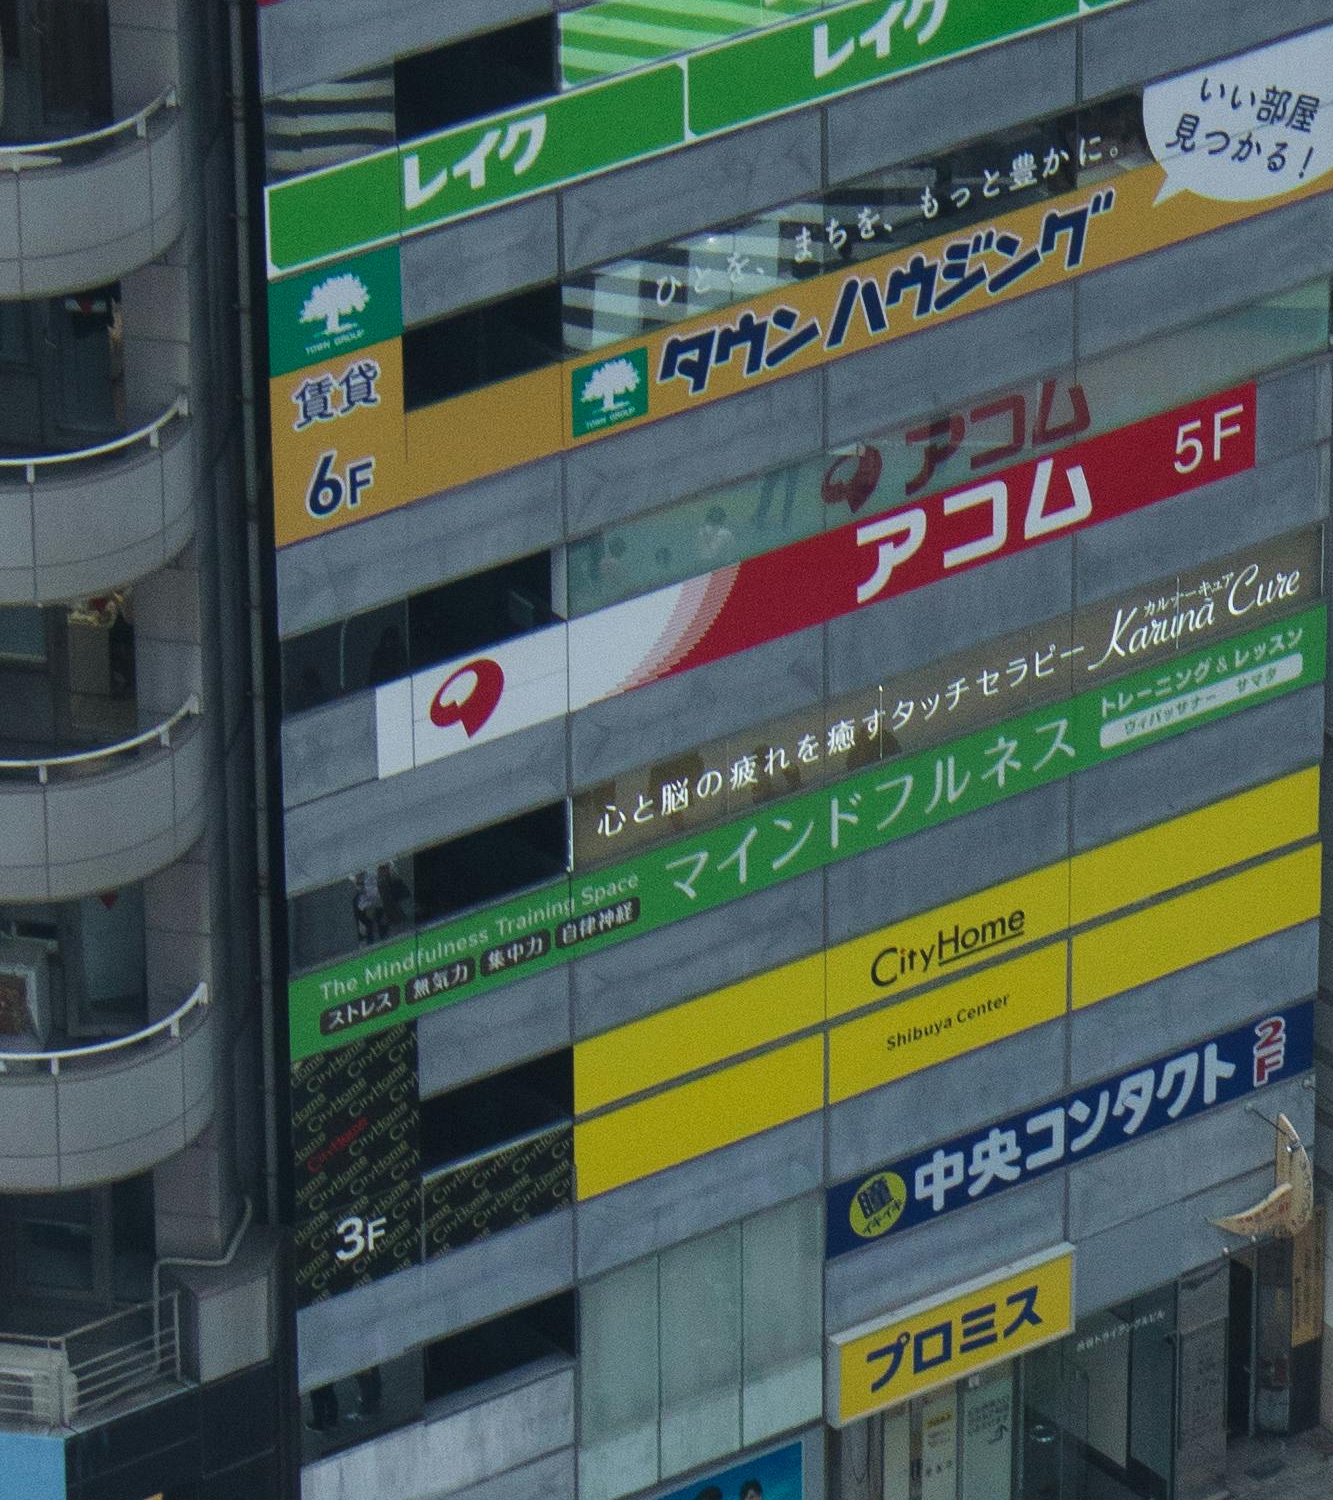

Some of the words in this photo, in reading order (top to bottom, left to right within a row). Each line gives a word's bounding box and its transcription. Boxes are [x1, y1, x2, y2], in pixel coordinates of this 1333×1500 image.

[1198, 76, 1322, 135] いい部屋
[403, 114, 549, 211] レイク
[654, 190, 1117, 396] タウンハウジング
[291, 361, 383, 433] 賃貸
[905, 377, 1092, 496] アコム
[1174, 402, 1245, 475] 5F
[305, 452, 375, 518] 6F
[855, 457, 1095, 605] アコム
[1227, 563, 1301, 616] Cure
[596, 642, 1087, 840] 心と脳の疲れを癒すタッチセラピー
[666, 716, 1077, 900] マインドフルネス
[321, 974, 358, 1001] The
[363, 926, 490, 987] Mindfulness
[495, 897, 577, 939] Training
[580, 872, 640, 909] Space
[487, 936, 544, 972] 集中力
[870, 908, 1027, 988] CityHome
[326, 990, 394, 1031] ストレス
[885, 1014, 954, 1052] Shibuya
[956, 992, 1011, 1029] Center
[1252, 1015, 1287, 1088] 2F
[914, 1043, 1237, 1212] 中央コンタクト
[335, 1215, 388, 1263] 3F
[865, 1283, 1044, 1395] プロミス
